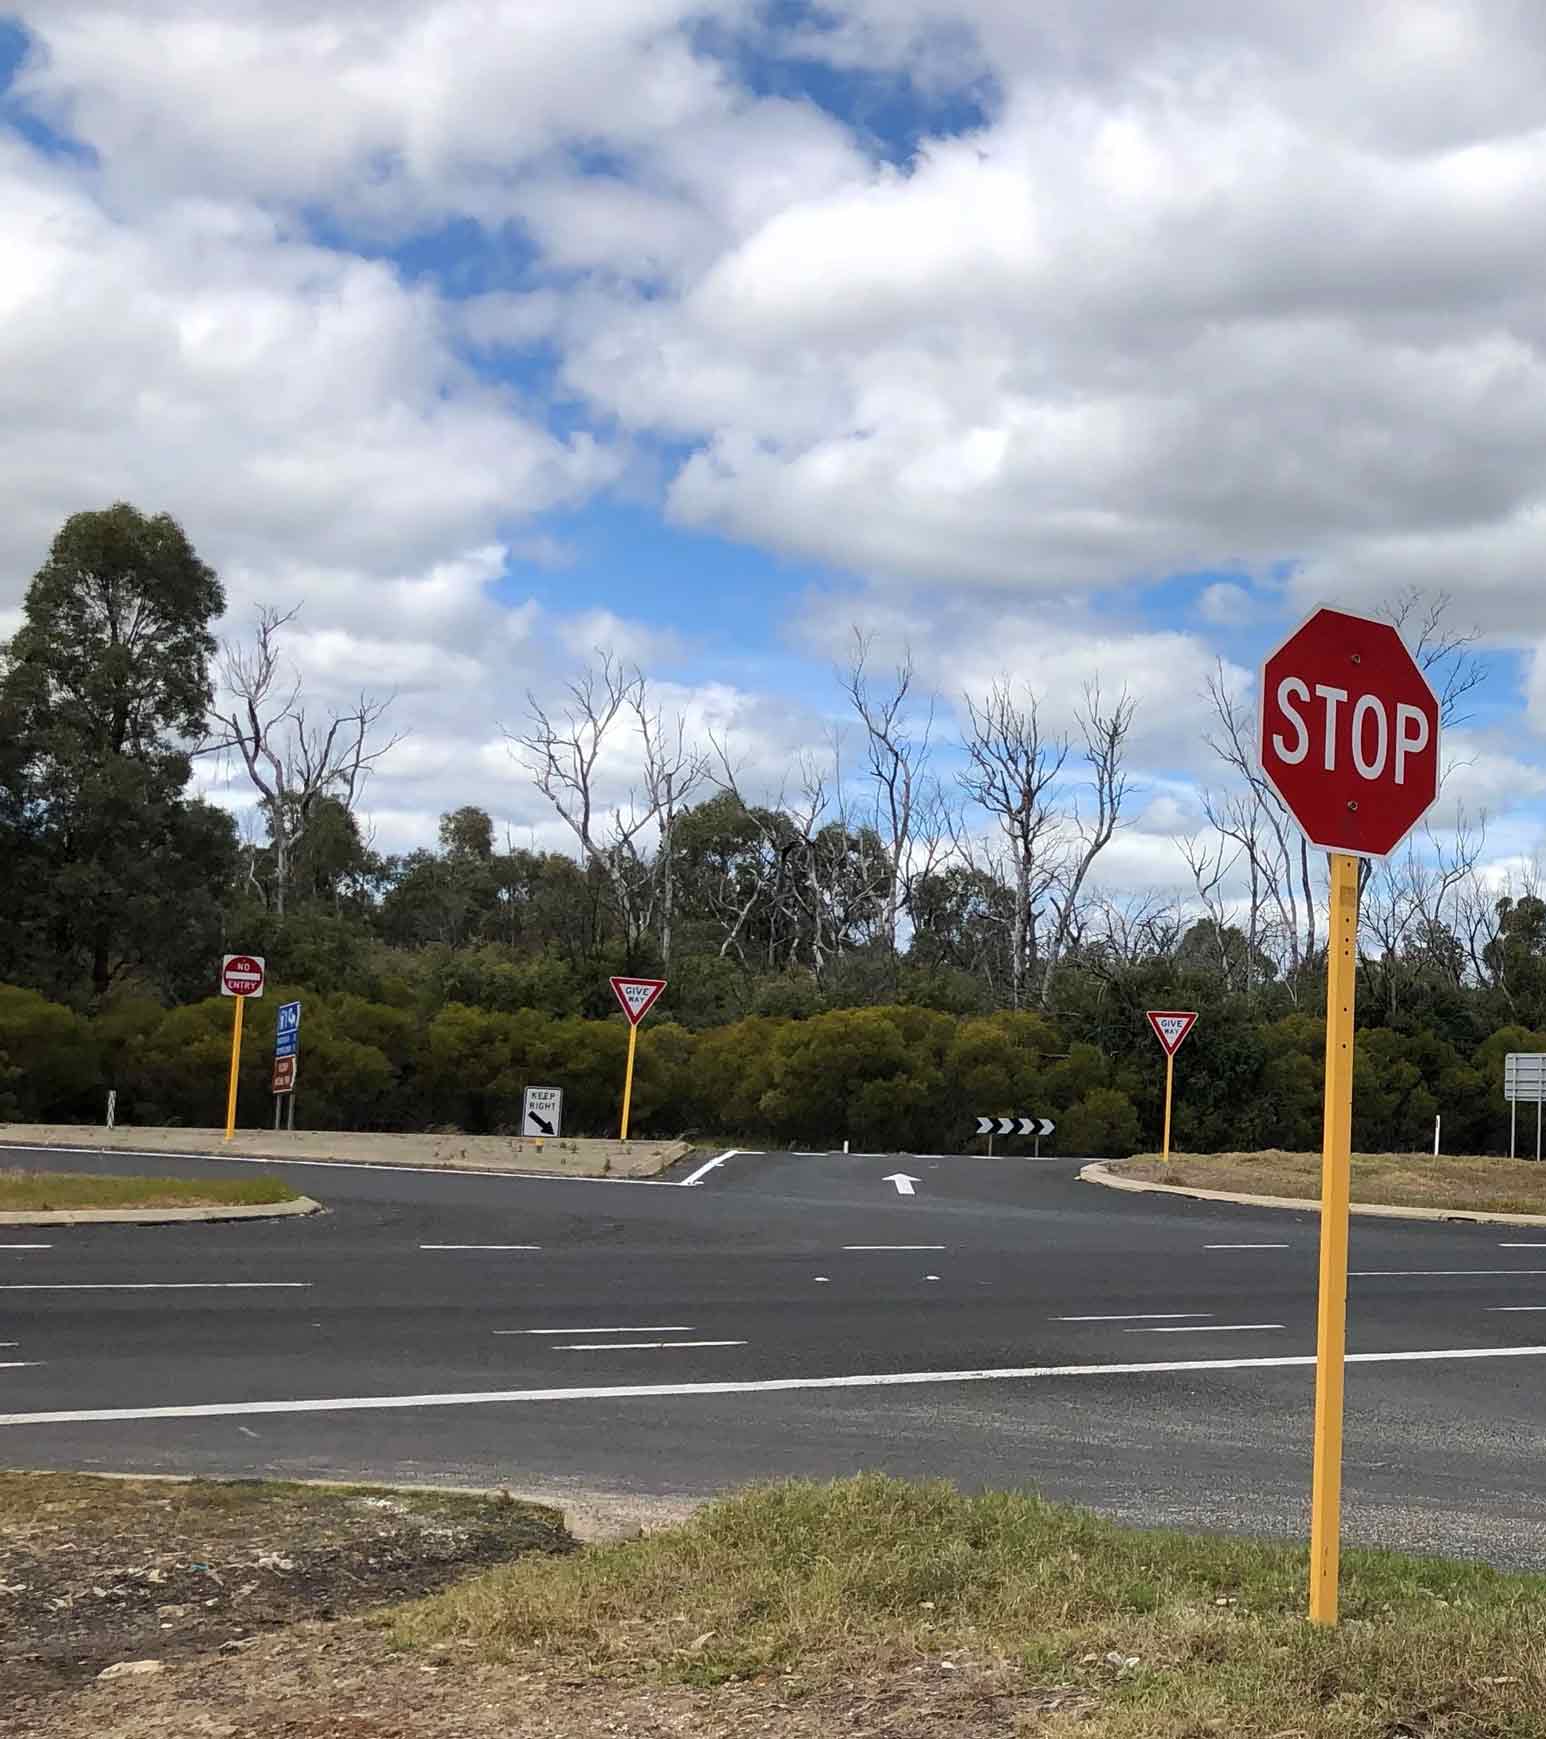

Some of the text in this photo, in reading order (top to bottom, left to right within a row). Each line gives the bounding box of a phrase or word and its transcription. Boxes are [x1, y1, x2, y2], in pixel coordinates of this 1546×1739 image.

[1273, 677, 1429, 785] STOP
[237, 963, 250, 971] NO
[228, 980, 257, 990] ENTRY
[625, 986, 650, 996] GIVE
[1161, 1020, 1183, 1028] GIVE
[531, 1092, 556, 1100] KEEP
[530, 1102, 556, 1111] RIGHT
